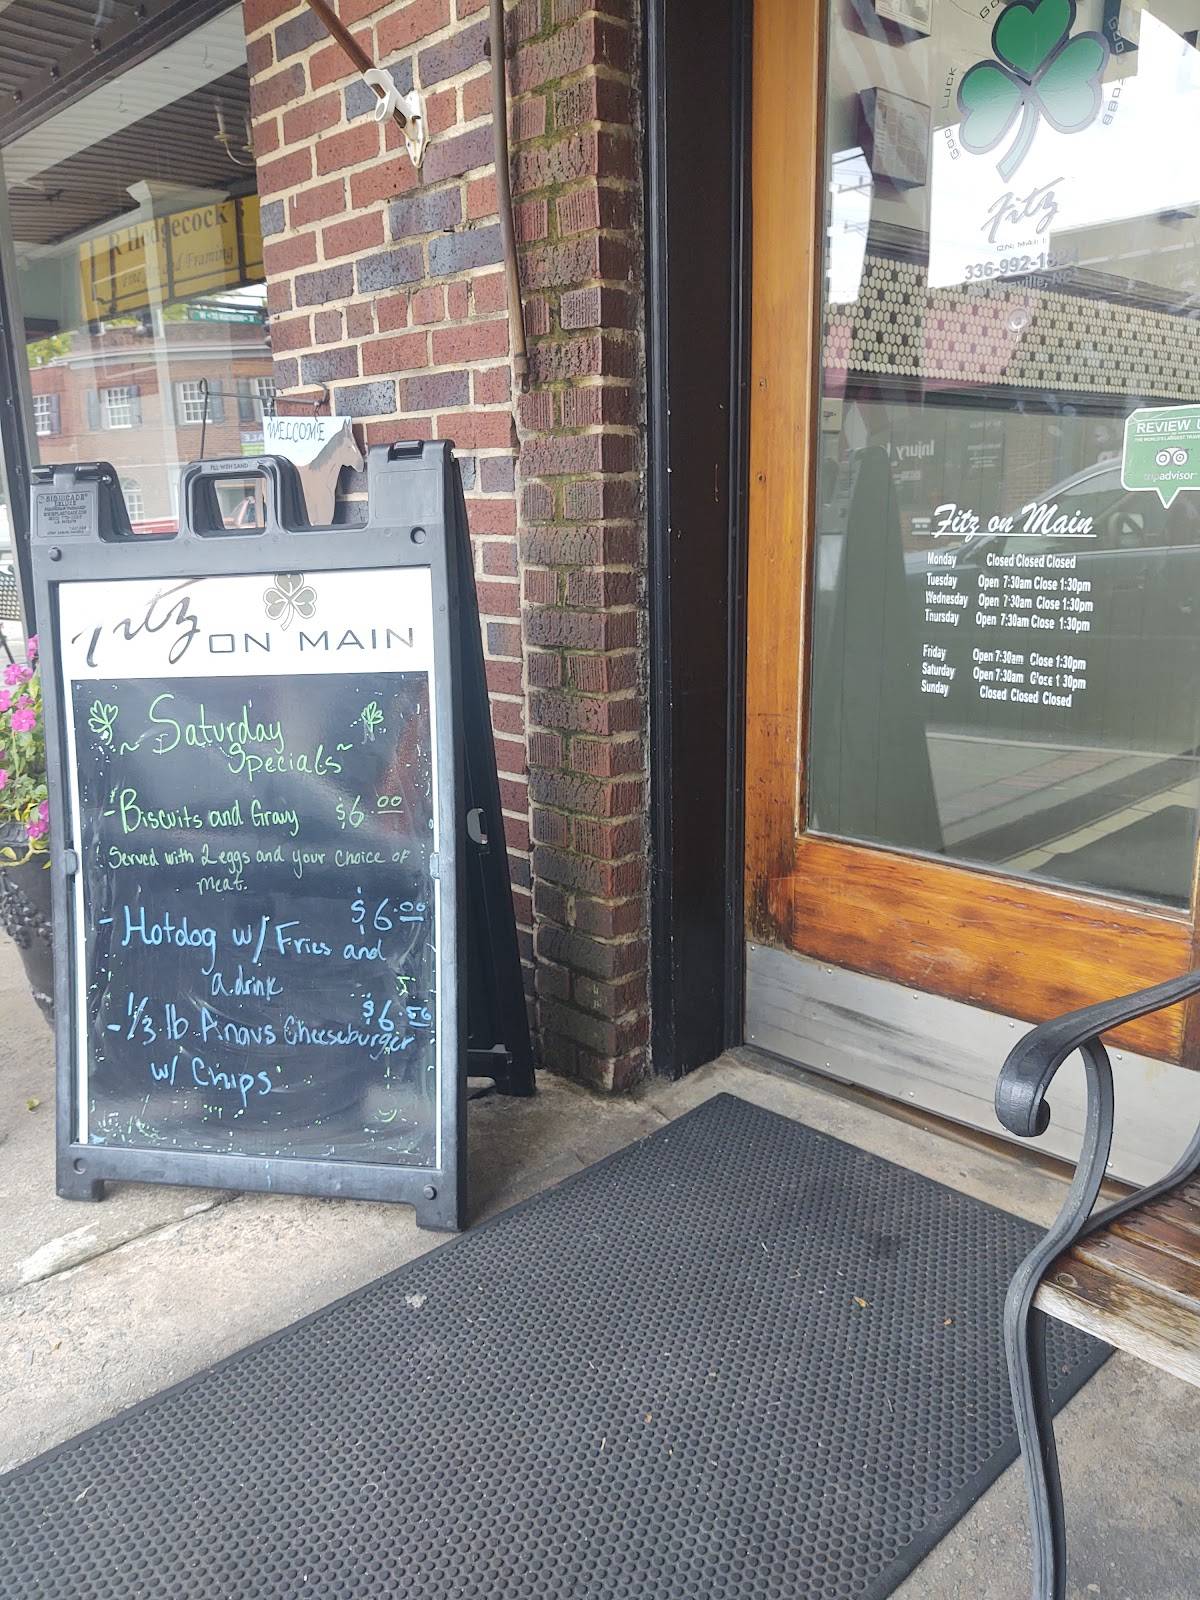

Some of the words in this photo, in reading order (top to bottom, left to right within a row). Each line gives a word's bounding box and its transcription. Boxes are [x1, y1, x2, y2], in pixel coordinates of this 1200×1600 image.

[942, 66, 957, 109] LUCK
[981, 176, 1065, 244] Fitz
[267, 421, 325, 442] WELCOME
[1136, 419, 1191, 433] REVIEW
[934, 503, 980, 543] Fitz
[987, 515, 1014, 533] on
[1021, 502, 1094, 538] Main
[928, 552, 957, 568] Monday
[986, 553, 1014, 567] Closed
[1016, 554, 1045, 568] Closed
[1047, 555, 1076, 569] Closed
[927, 573, 957, 589] Tuesday
[978, 575, 999, 590] Open
[1003, 576, 1032, 590] 7:30am
[1034, 577, 1057, 591] Close
[1060, 577, 1091, 594] 1:30pm
[925, 591, 968, 608] Wednesday
[979, 593, 999, 608] Open
[1003, 594, 1032, 609] 7:30am
[1036, 596, 1060, 610] Close
[1062, 598, 1093, 613] 1:30pm
[925, 609, 959, 626] Thursday
[976, 612, 996, 627] Open
[1000, 613, 1029, 628] 7:30am
[1031, 615, 1054, 629] Close
[1059, 617, 1090, 634] 1:30pm
[208, 632, 271, 655] ON
[299, 627, 414, 652] MAIN
[923, 644, 946, 661] Friday
[973, 648, 993, 664] Open
[995, 650, 1024, 665] 7:30am
[1030, 652, 1053, 667] Close
[1056, 654, 1086, 672] 1:30pm
[922, 662, 956, 680] Saturday
[973, 667, 993, 682] Open
[995, 668, 1024, 683] 7:30am
[1056, 674, 1086, 691] 130pm
[921, 680, 949, 697] Sunday
[979, 685, 1007, 701] Closed
[1011, 688, 1039, 704] Closed
[1042, 691, 1072, 707] Closed
[149, 693, 285, 755] Saturday
[208, 799, 244, 828] and
[251, 799, 299, 837] Gravy
[108, 845, 160, 870] Served
[164, 848, 195, 866] with
[218, 849, 251, 874] eggs
[256, 845, 285, 863] and
[292, 849, 326, 880] your
[391, 850, 411, 864] of
[121, 905, 218, 976] Hotdog
[232, 915, 270, 964] w/
[275, 920, 331, 956] Fries
[343, 937, 387, 963] and
[234, 964, 284, 1001] drink
[127, 991, 157, 1046] 1/3
[165, 1003, 190, 1040] lb
[283, 1014, 416, 1060] Cheeseburger
[150, 1055, 179, 1087] w/
[191, 1056, 273, 1108] Chips
